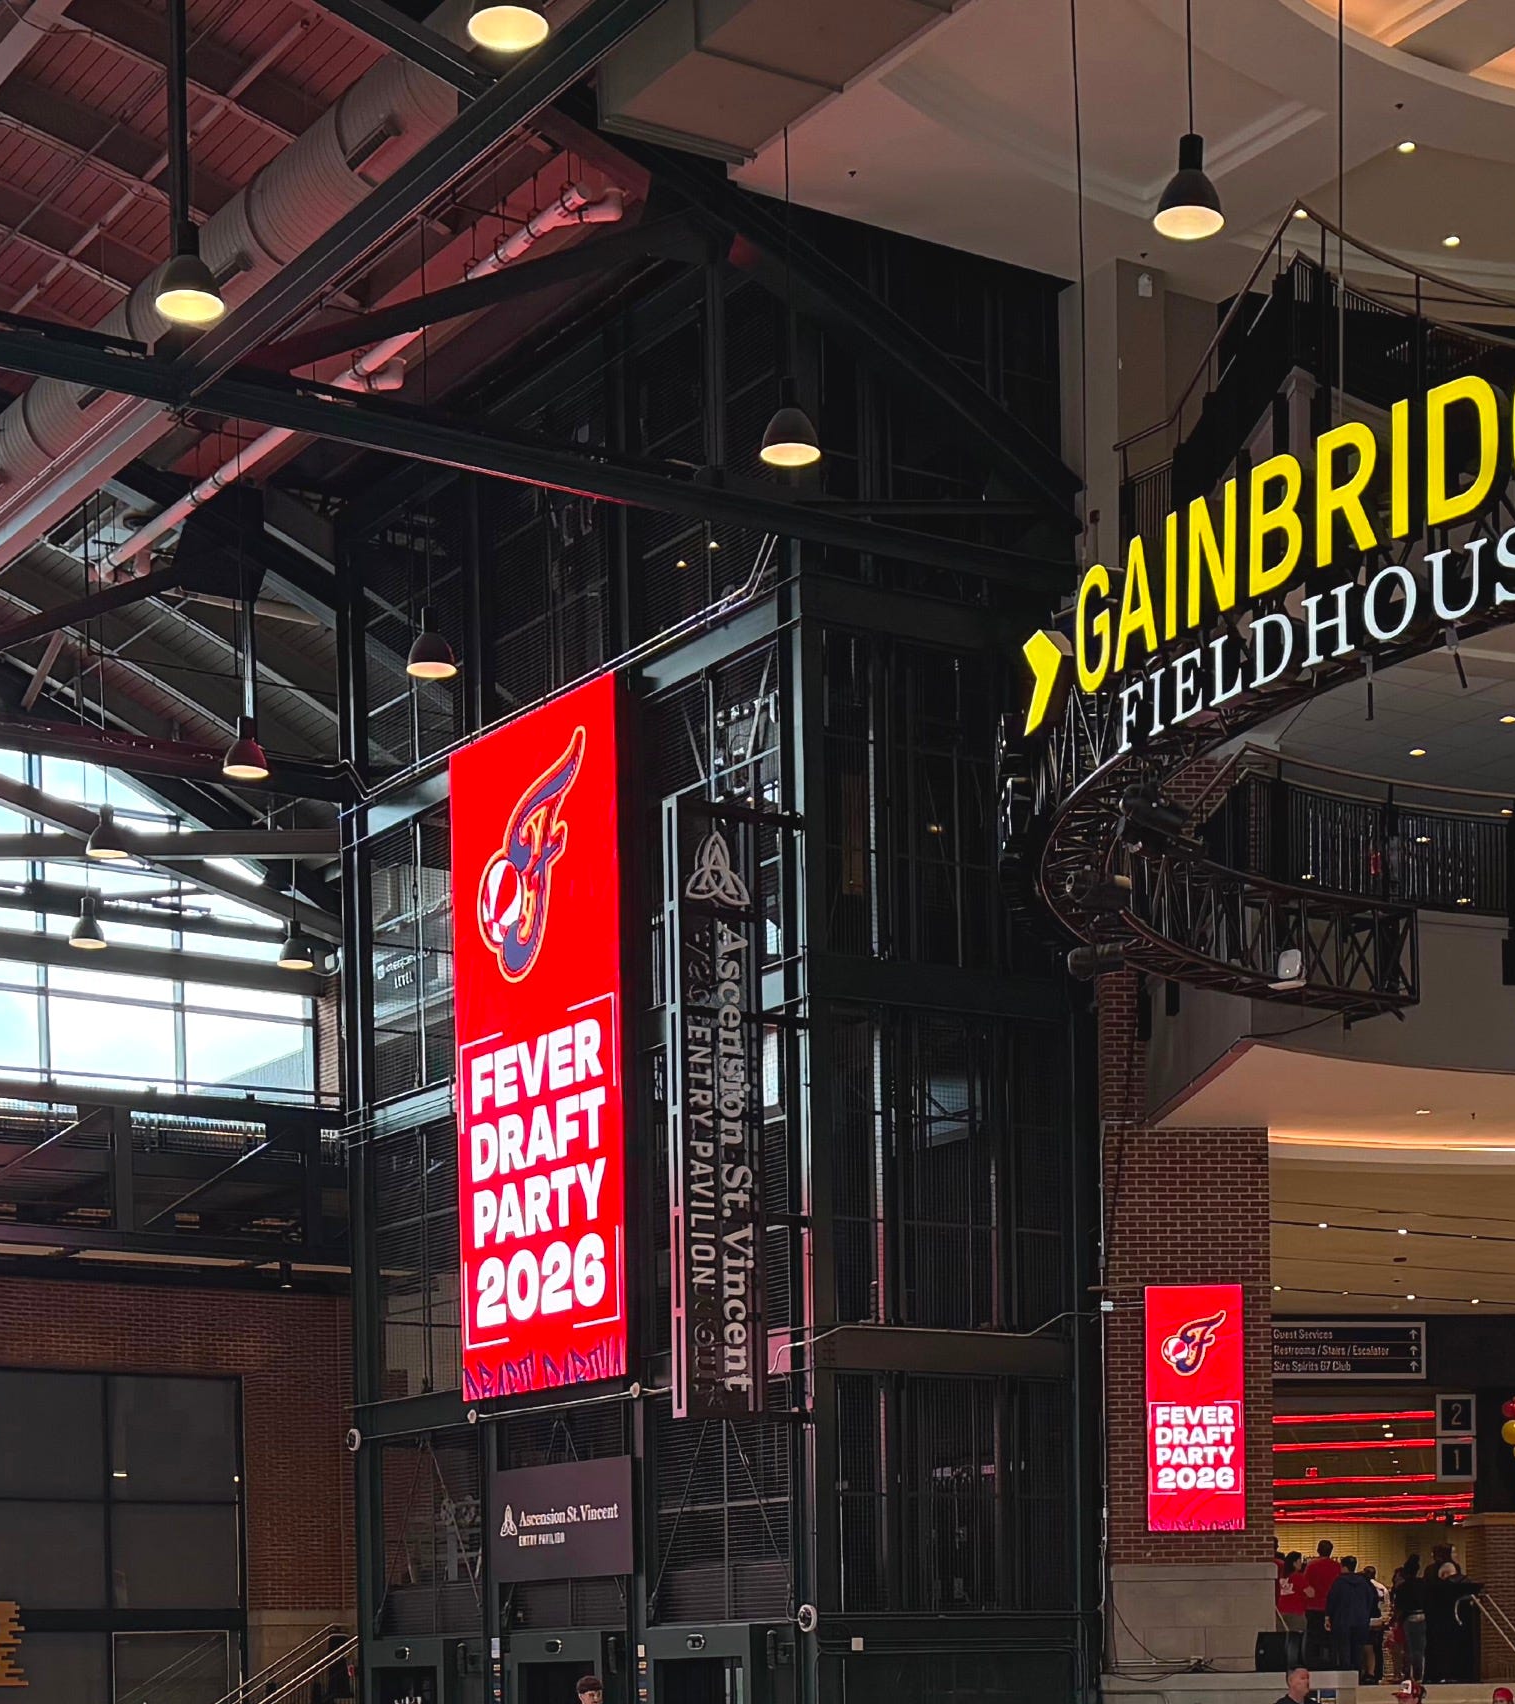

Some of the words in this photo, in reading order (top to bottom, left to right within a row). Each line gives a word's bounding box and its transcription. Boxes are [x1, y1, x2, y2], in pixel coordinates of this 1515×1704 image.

[470, 1017, 602, 1117] FEVER
[716, 921, 751, 1147] Ascension
[688, 1025, 714, 1128] ENTRY
[470, 1086, 607, 1184] DRAFT
[472, 1156, 607, 1250] PARTY
[689, 1139, 716, 1287] PAVILION
[721, 1161, 753, 1218] St.
[476, 1241, 607, 1329] 2026
[723, 1222, 755, 1393] Vincent
[1155, 1405, 1234, 1425] FEVER
[1155, 1425, 1236, 1446] DRAFT
[1450, 1402, 1463, 1427] 2
[1155, 1445, 1235, 1466] PARTY
[1157, 1466, 1236, 1491] 2026
[1453, 1449, 1461, 1472] 1
[518, 1507, 566, 1527] Ascension
[566, 1504, 581, 1524] St.
[580, 1502, 619, 1522] Vincent
